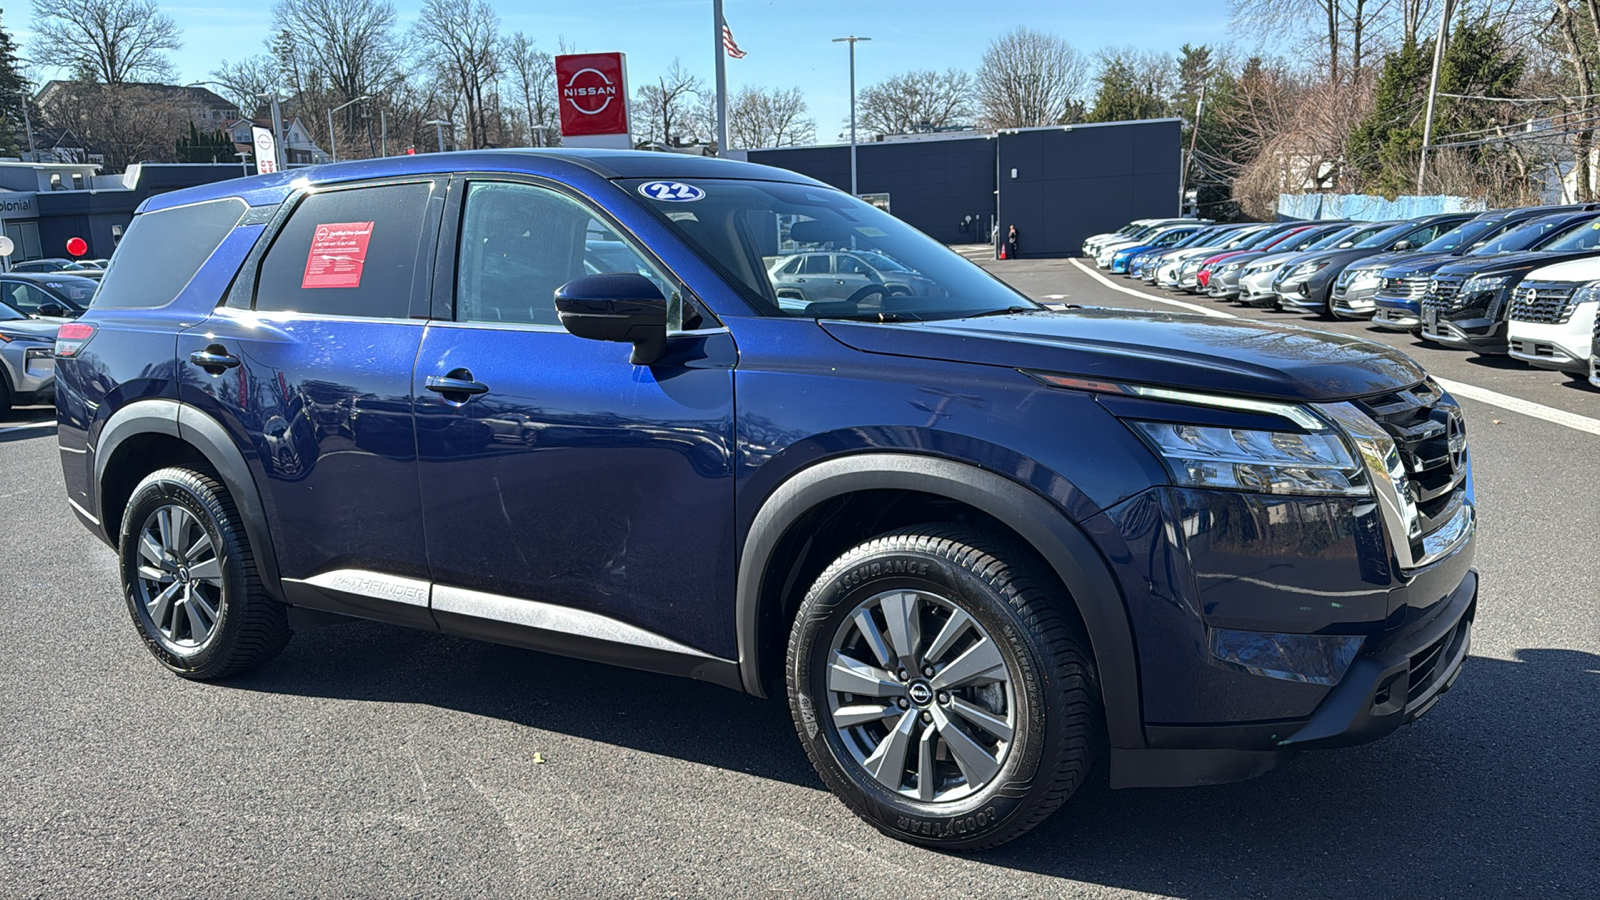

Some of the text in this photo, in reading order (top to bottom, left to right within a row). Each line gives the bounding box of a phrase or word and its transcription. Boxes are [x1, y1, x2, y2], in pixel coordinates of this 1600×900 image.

[564, 86, 616, 97] NISSAN
[651, 182, 696, 199] 22
[331, 575, 428, 601] PATHFINDER
[835, 560, 930, 596] ASSURANCE
[896, 806, 998, 838] GOODYEAR
